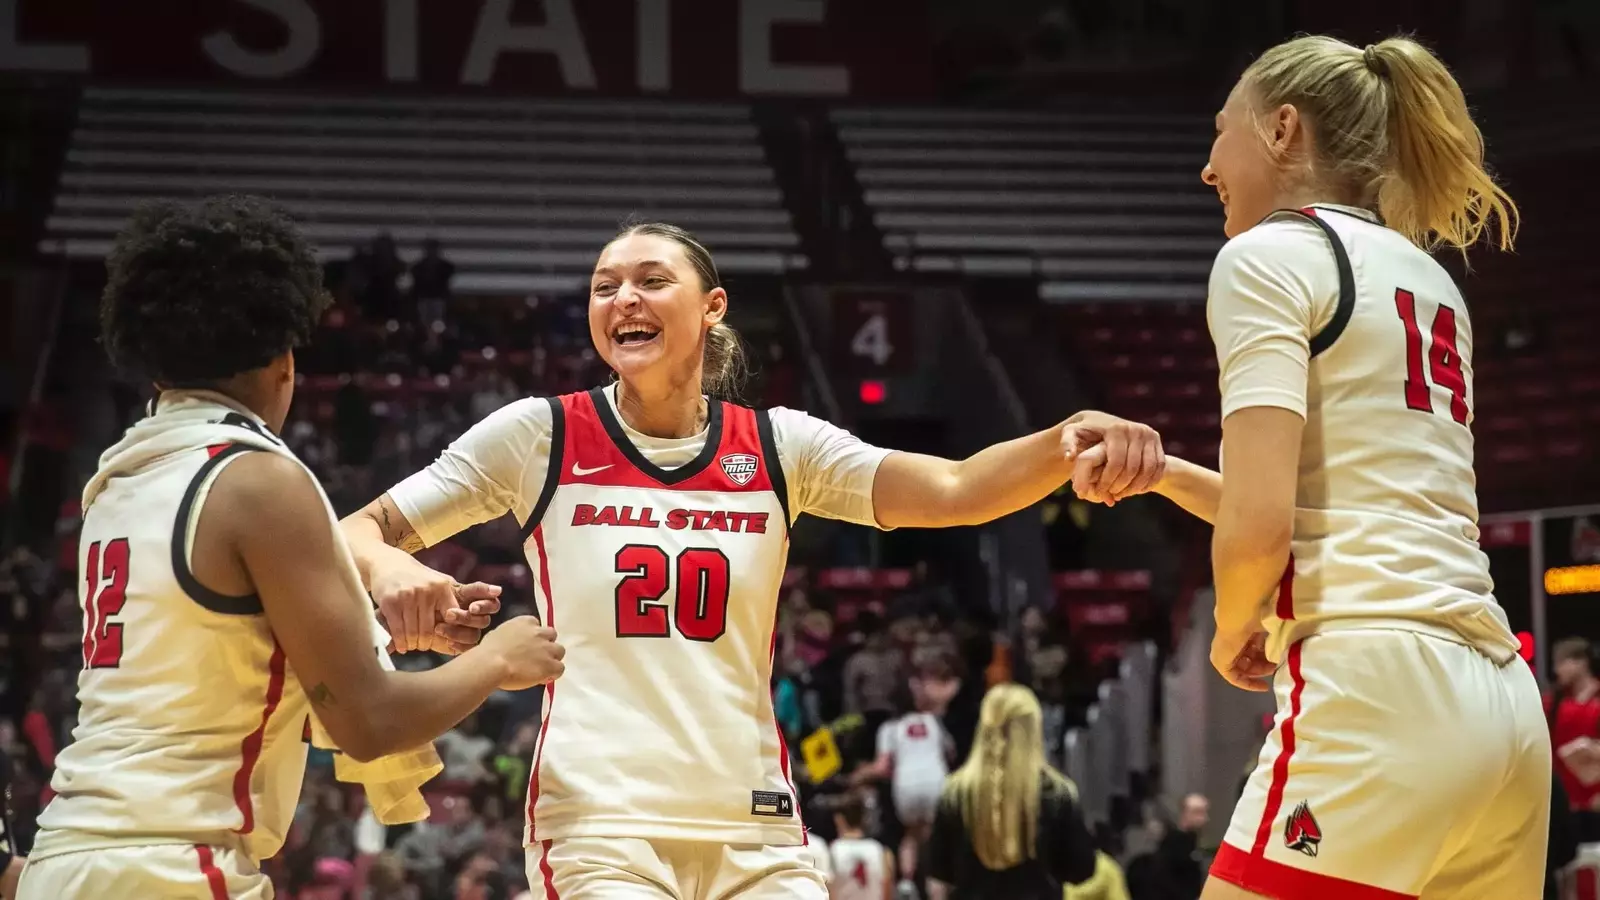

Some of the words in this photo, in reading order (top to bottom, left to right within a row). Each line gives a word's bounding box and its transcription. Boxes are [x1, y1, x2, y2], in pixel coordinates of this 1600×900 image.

[850, 315, 895, 366] 4
[1395, 287, 1469, 427] 14
[724, 463, 757, 474] MAC
[571, 504, 659, 528] BALL
[665, 505, 769, 534] STATE
[83, 537, 131, 670] 12
[614, 543, 730, 643] 20
[781, 799, 789, 810] M
